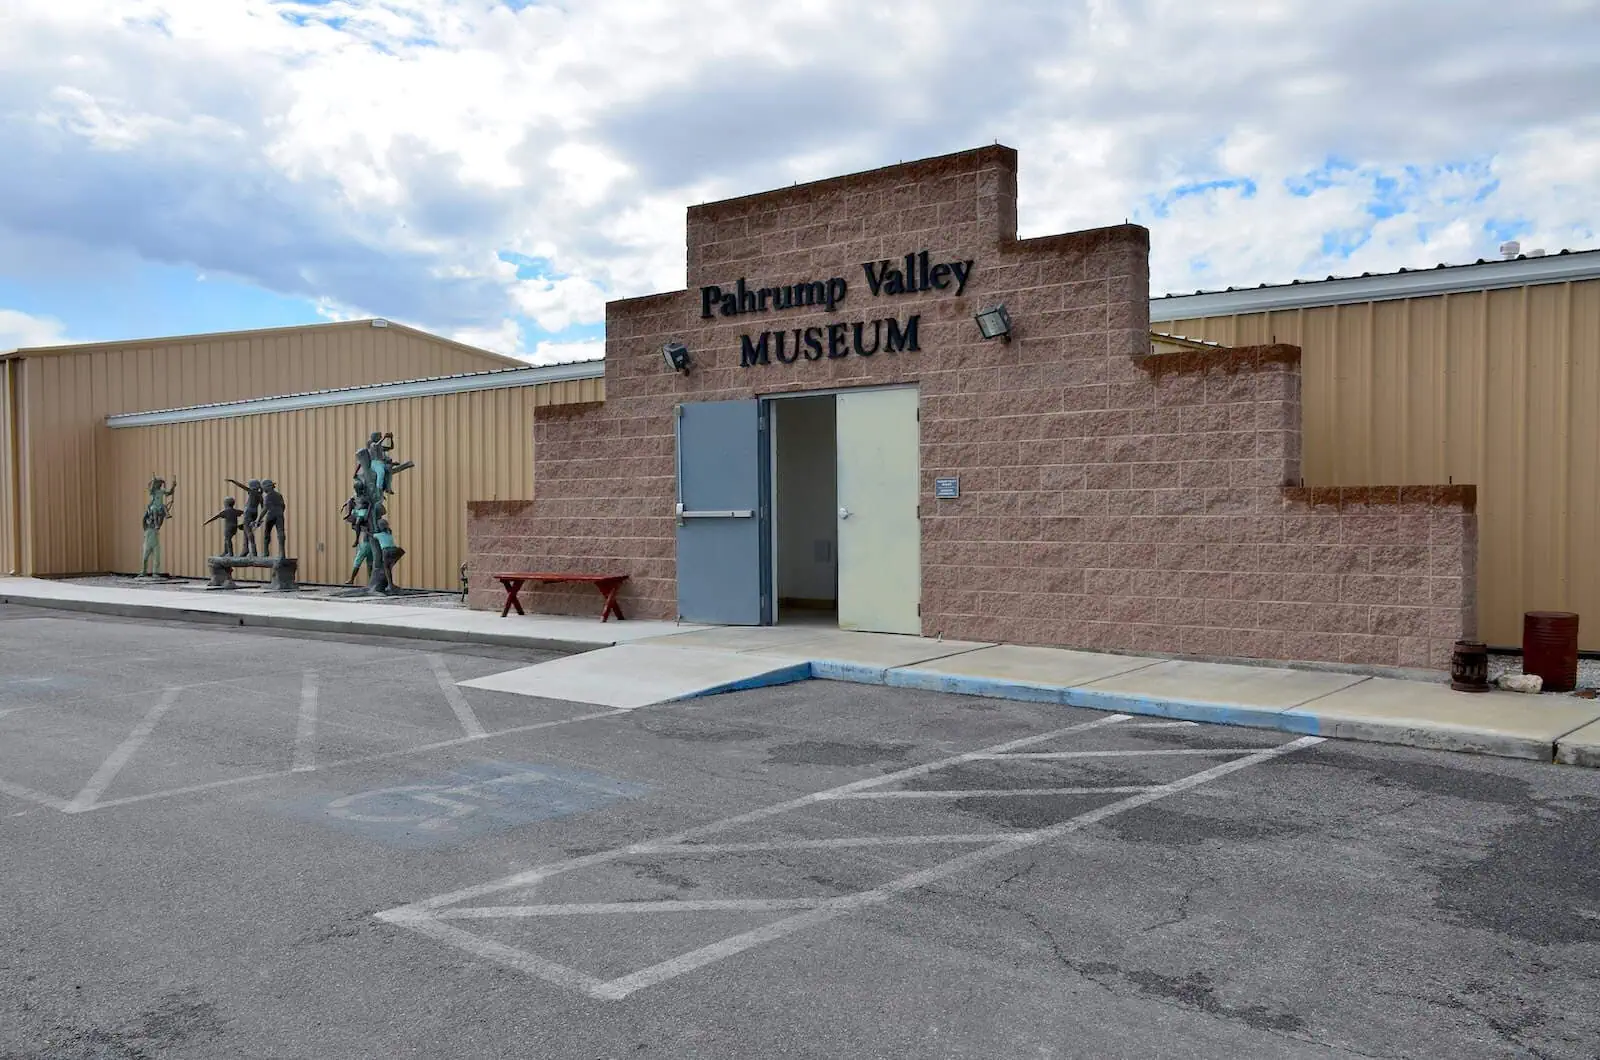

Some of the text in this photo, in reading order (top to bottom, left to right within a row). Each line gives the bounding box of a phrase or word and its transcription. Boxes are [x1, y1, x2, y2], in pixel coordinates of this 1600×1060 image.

[700, 250, 974, 319] Pahrump Valley
[739, 314, 921, 368] MUSEUM
